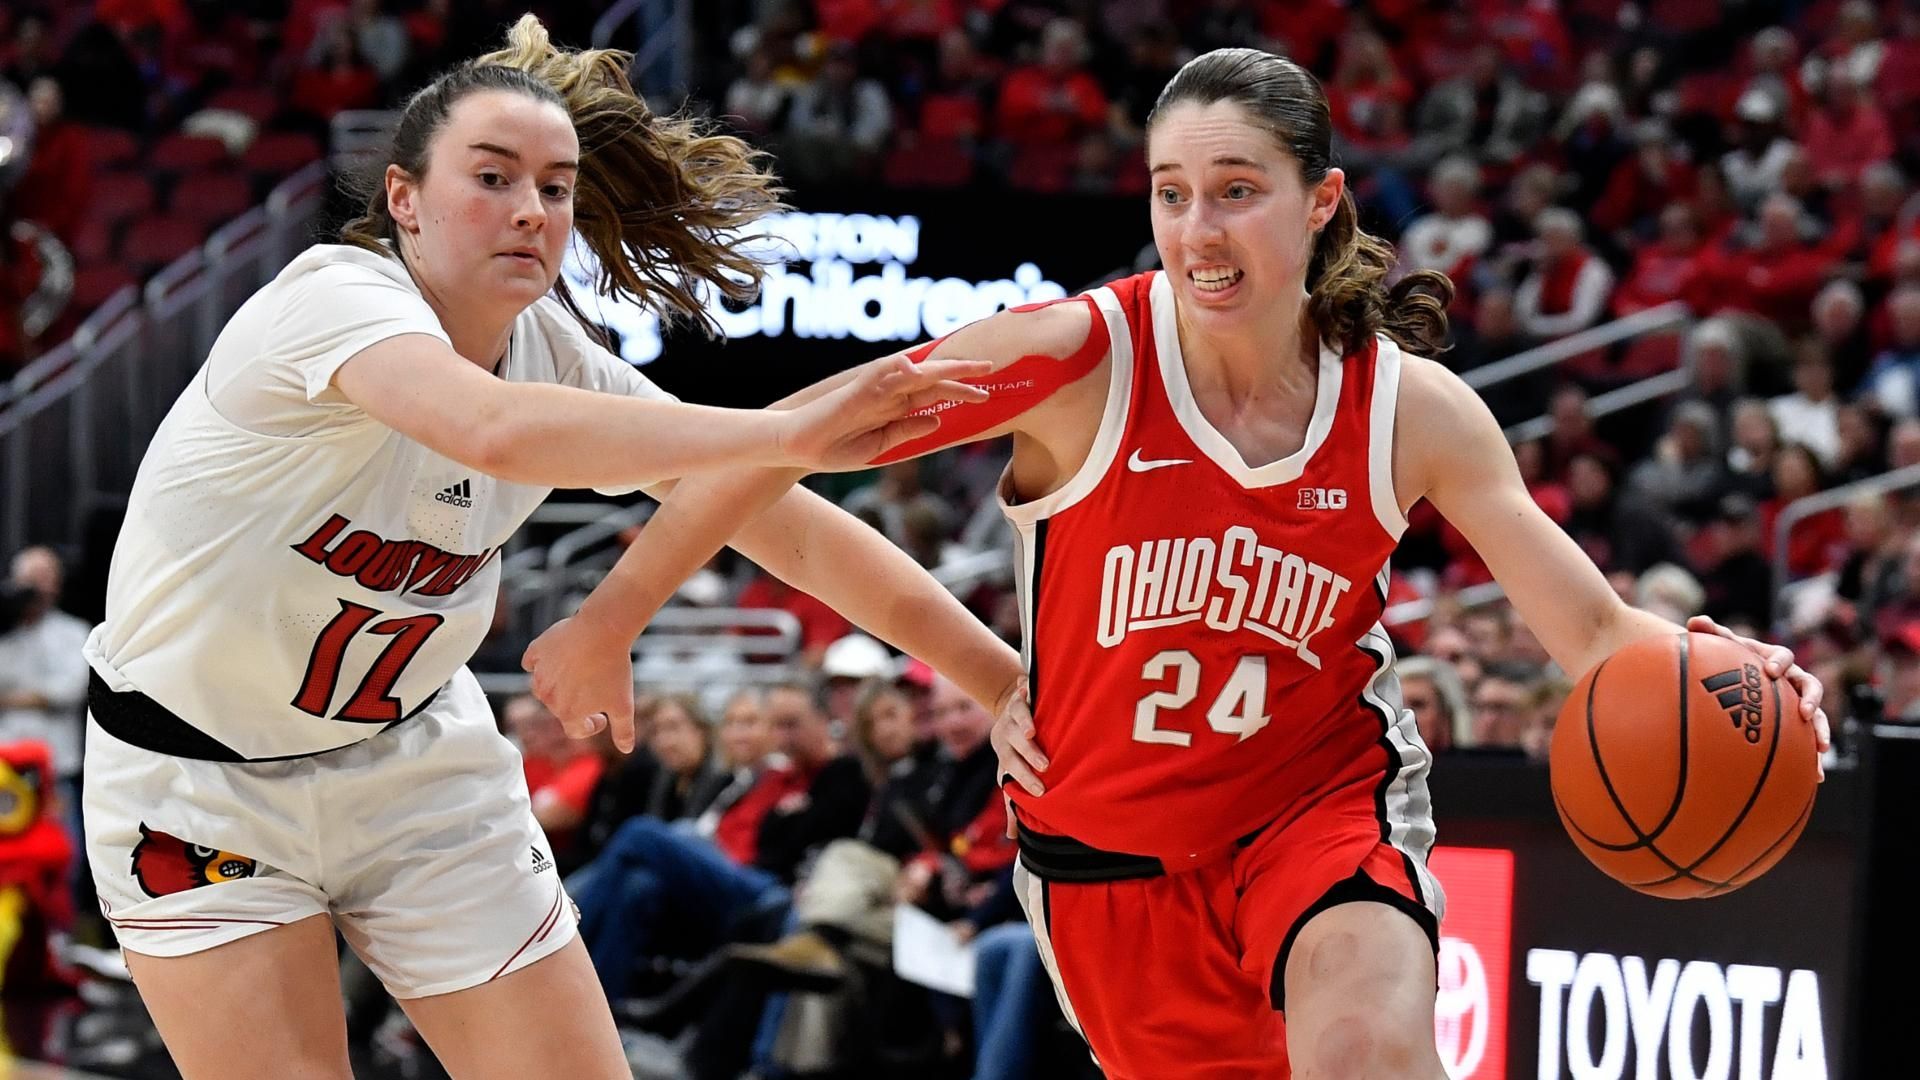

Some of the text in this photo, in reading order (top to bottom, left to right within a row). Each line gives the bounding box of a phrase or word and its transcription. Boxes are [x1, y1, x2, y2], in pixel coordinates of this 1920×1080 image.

[434, 491, 473, 509] adidas
[289, 597, 446, 724] 12
[1132, 649, 1273, 748] 24
[1743, 663, 1762, 744] adidas
[1526, 948, 1829, 1080] TOYOTA
